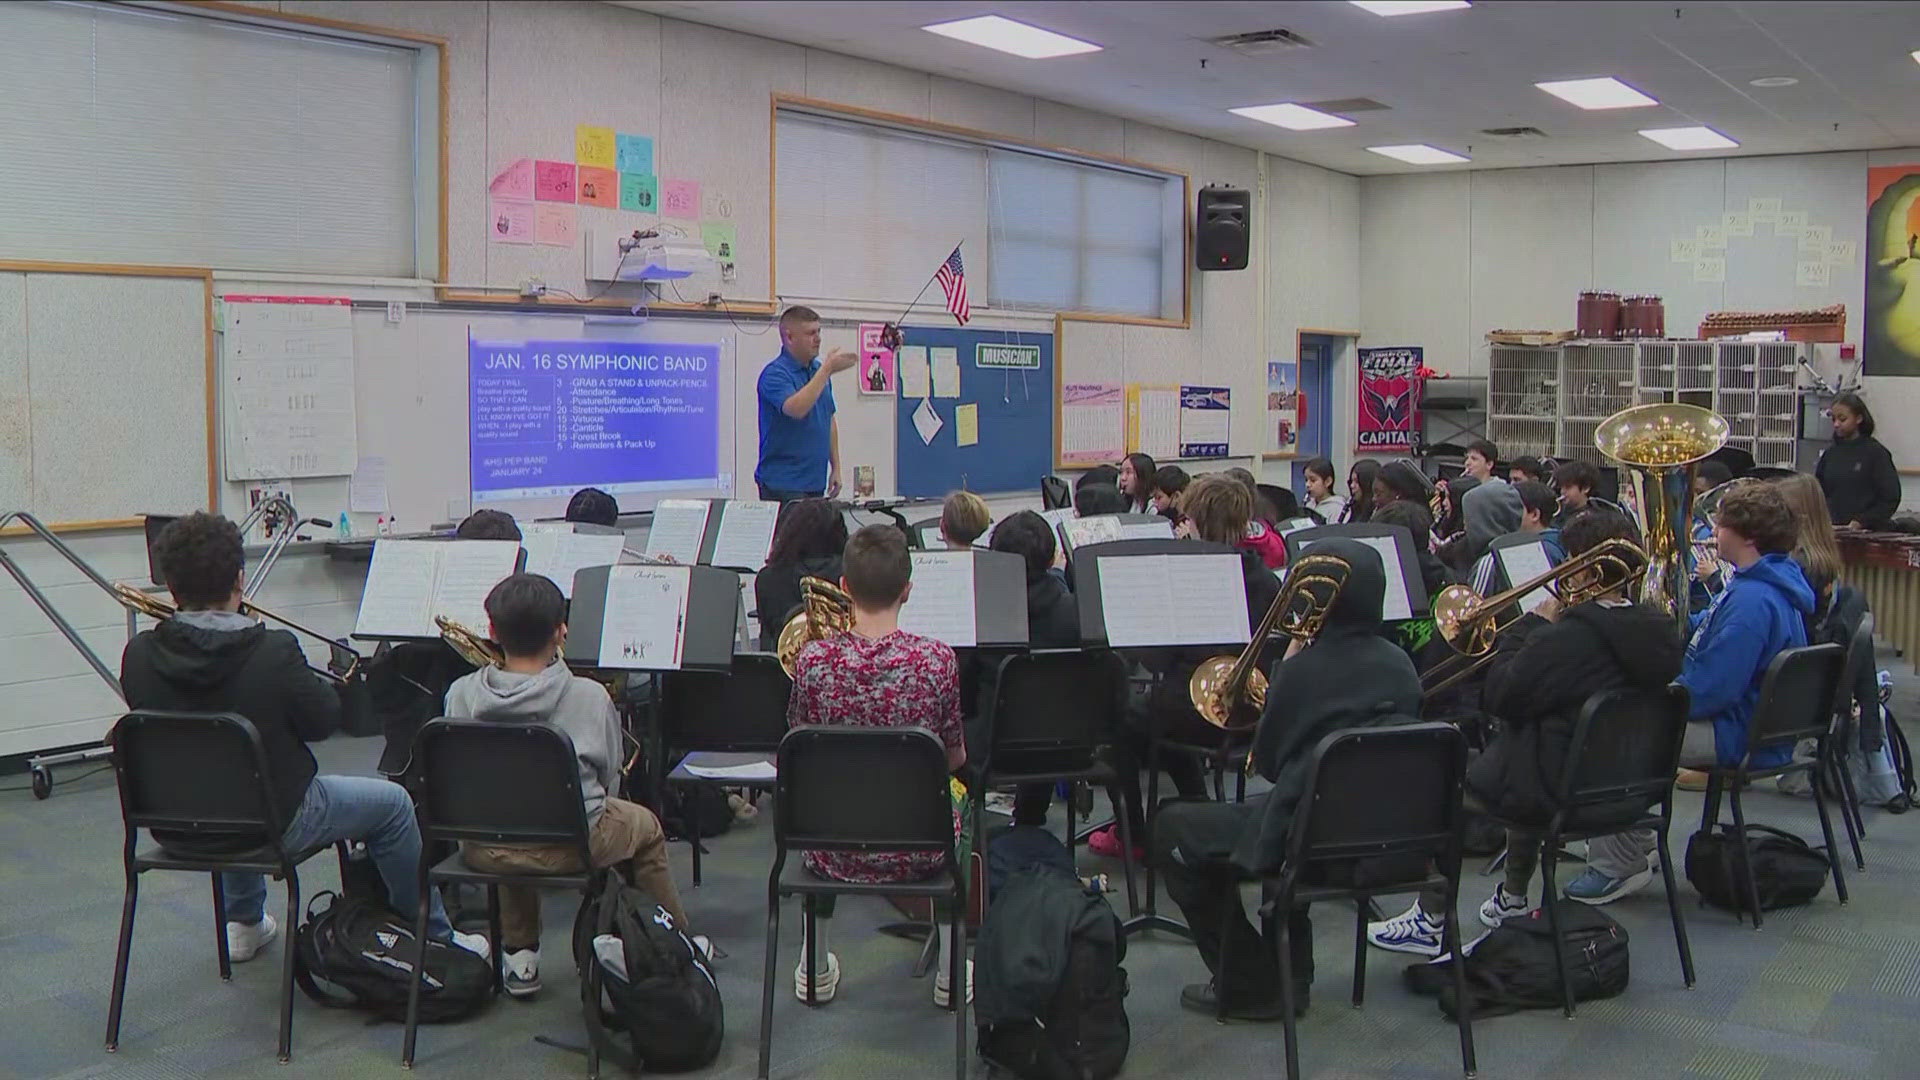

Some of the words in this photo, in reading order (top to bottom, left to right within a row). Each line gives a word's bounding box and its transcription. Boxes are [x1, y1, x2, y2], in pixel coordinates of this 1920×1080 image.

[982, 348, 1032, 364] MUSICIAN
[485, 353, 525, 369] JAN.
[532, 353, 551, 369] 16
[556, 353, 659, 371] SYMPHONIC
[663, 356, 707, 372] BAND
[1363, 355, 1417, 368] FINAL
[556, 378, 562, 388] 3
[599, 378, 606, 387] A
[607, 378, 635, 388] STAND
[637, 379, 643, 387] &
[662, 397, 683, 405] Tones
[556, 406, 567, 415] 20
[557, 415, 567, 423] 15
[557, 424, 567, 432] 15
[557, 433, 567, 441] 15
[599, 432, 621, 440] Brook
[1359, 431, 1420, 444] CAPITALS
[624, 440, 643, 449] Pack
[644, 440, 656, 450] Up
[504, 457, 522, 466] PEP
[523, 456, 547, 465] BAND
[490, 467, 531, 478] JANUARY
[532, 467, 542, 475] 24
